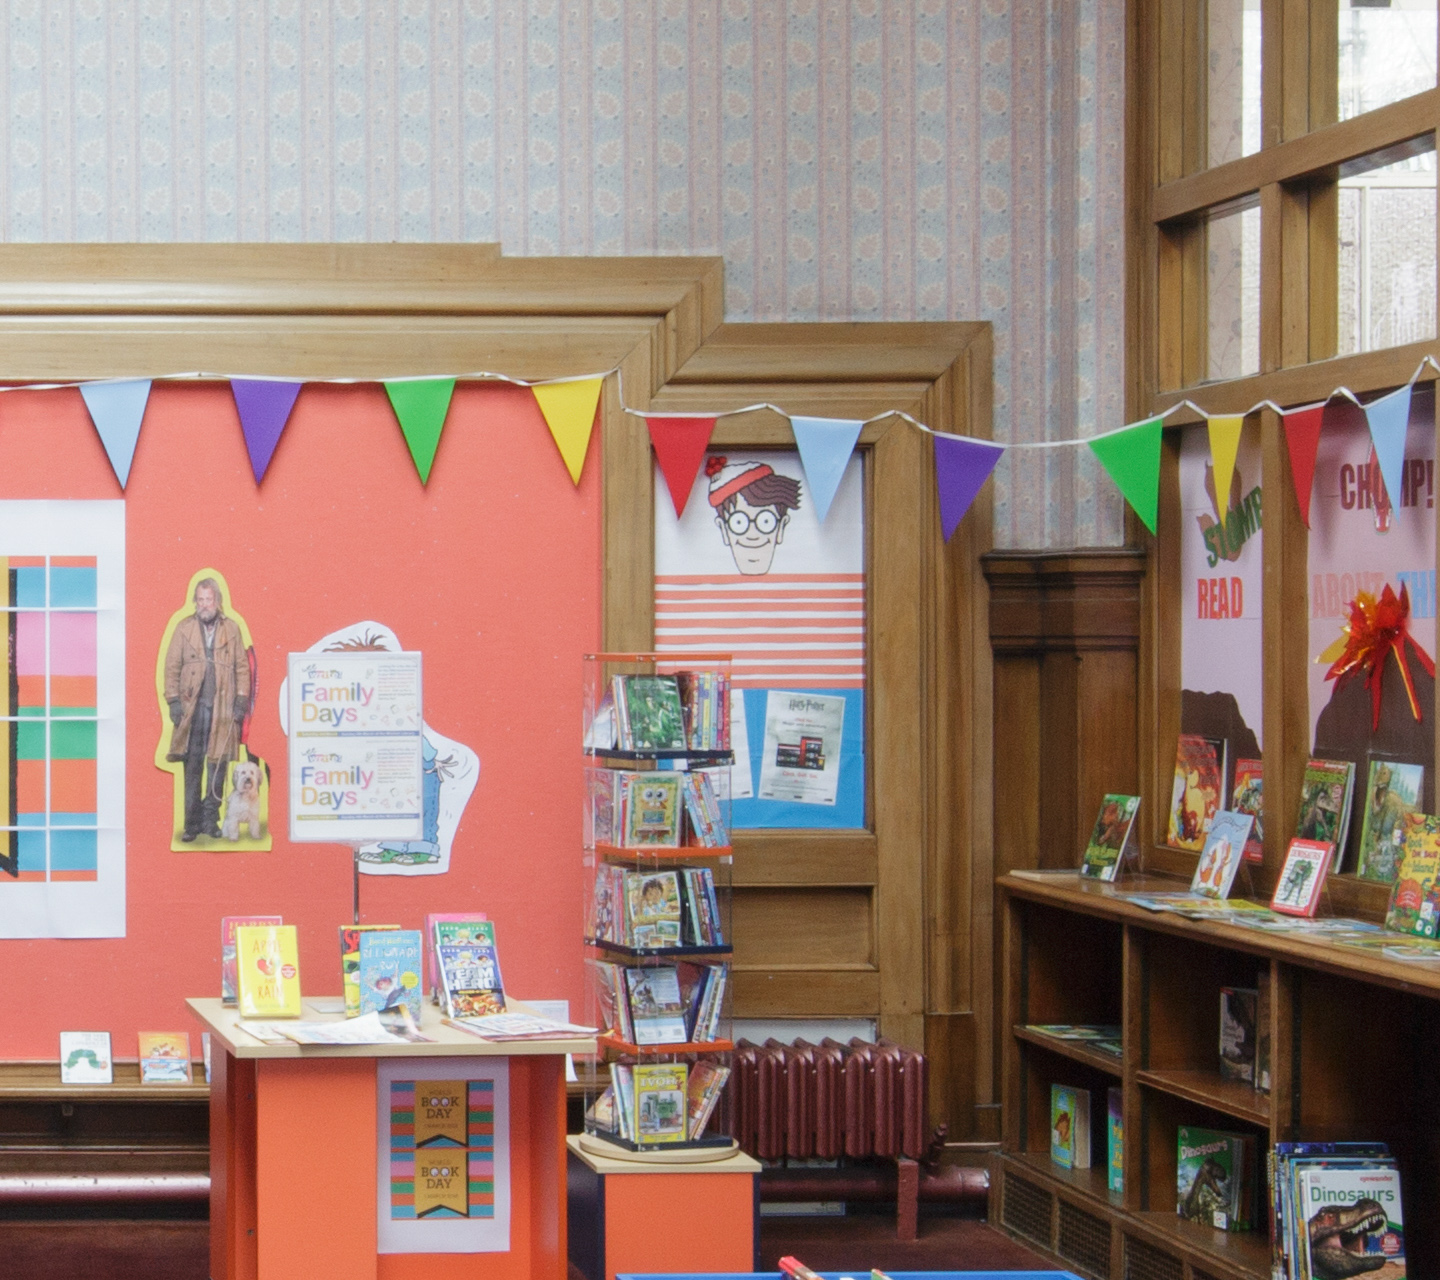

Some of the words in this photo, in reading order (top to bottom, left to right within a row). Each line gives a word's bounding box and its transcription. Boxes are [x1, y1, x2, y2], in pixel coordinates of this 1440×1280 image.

[1197, 577, 1243, 619] READ
[302, 682, 374, 706] Family
[302, 703, 358, 727] Days
[301, 766, 373, 789] Family
[302, 787, 357, 810] Days
[421, 1096, 459, 1108] BOOK
[426, 1108, 451, 1119] DAY
[421, 1167, 459, 1178] BOOK
[426, 1178, 452, 1189] DAY
[1311, 1186, 1395, 1204] Dinosaurs
